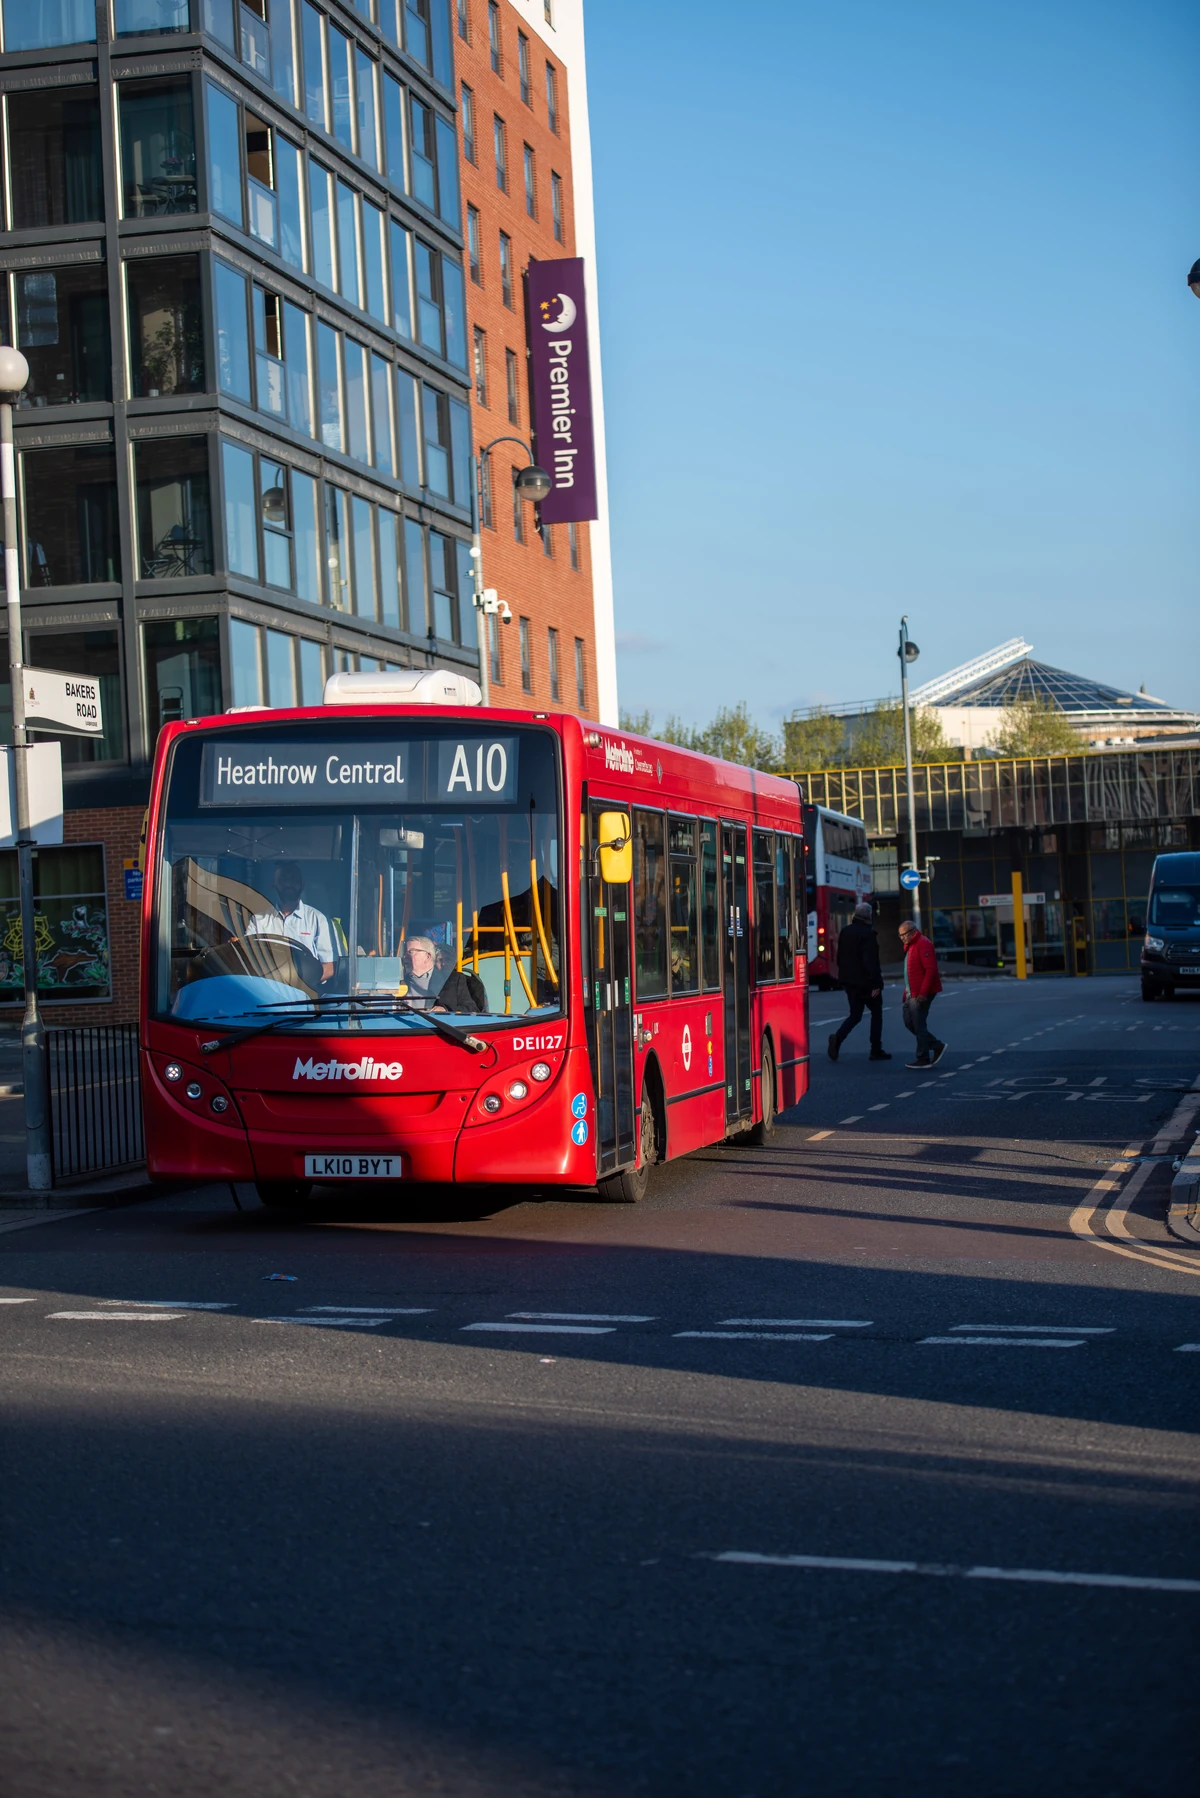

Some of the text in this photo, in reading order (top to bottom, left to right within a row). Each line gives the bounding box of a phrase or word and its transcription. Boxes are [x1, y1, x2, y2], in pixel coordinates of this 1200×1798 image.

[548, 340, 578, 489] Premier Inn
[65, 682, 96, 700] BAKERS
[76, 702, 97, 719] ROAD
[217, 755, 405, 785] Heathrow Central
[446, 743, 507, 792] A10
[512, 1035, 563, 1051] DE1127
[292, 1056, 403, 1081] Metroline
[312, 1158, 393, 1175] LK10 BYT
